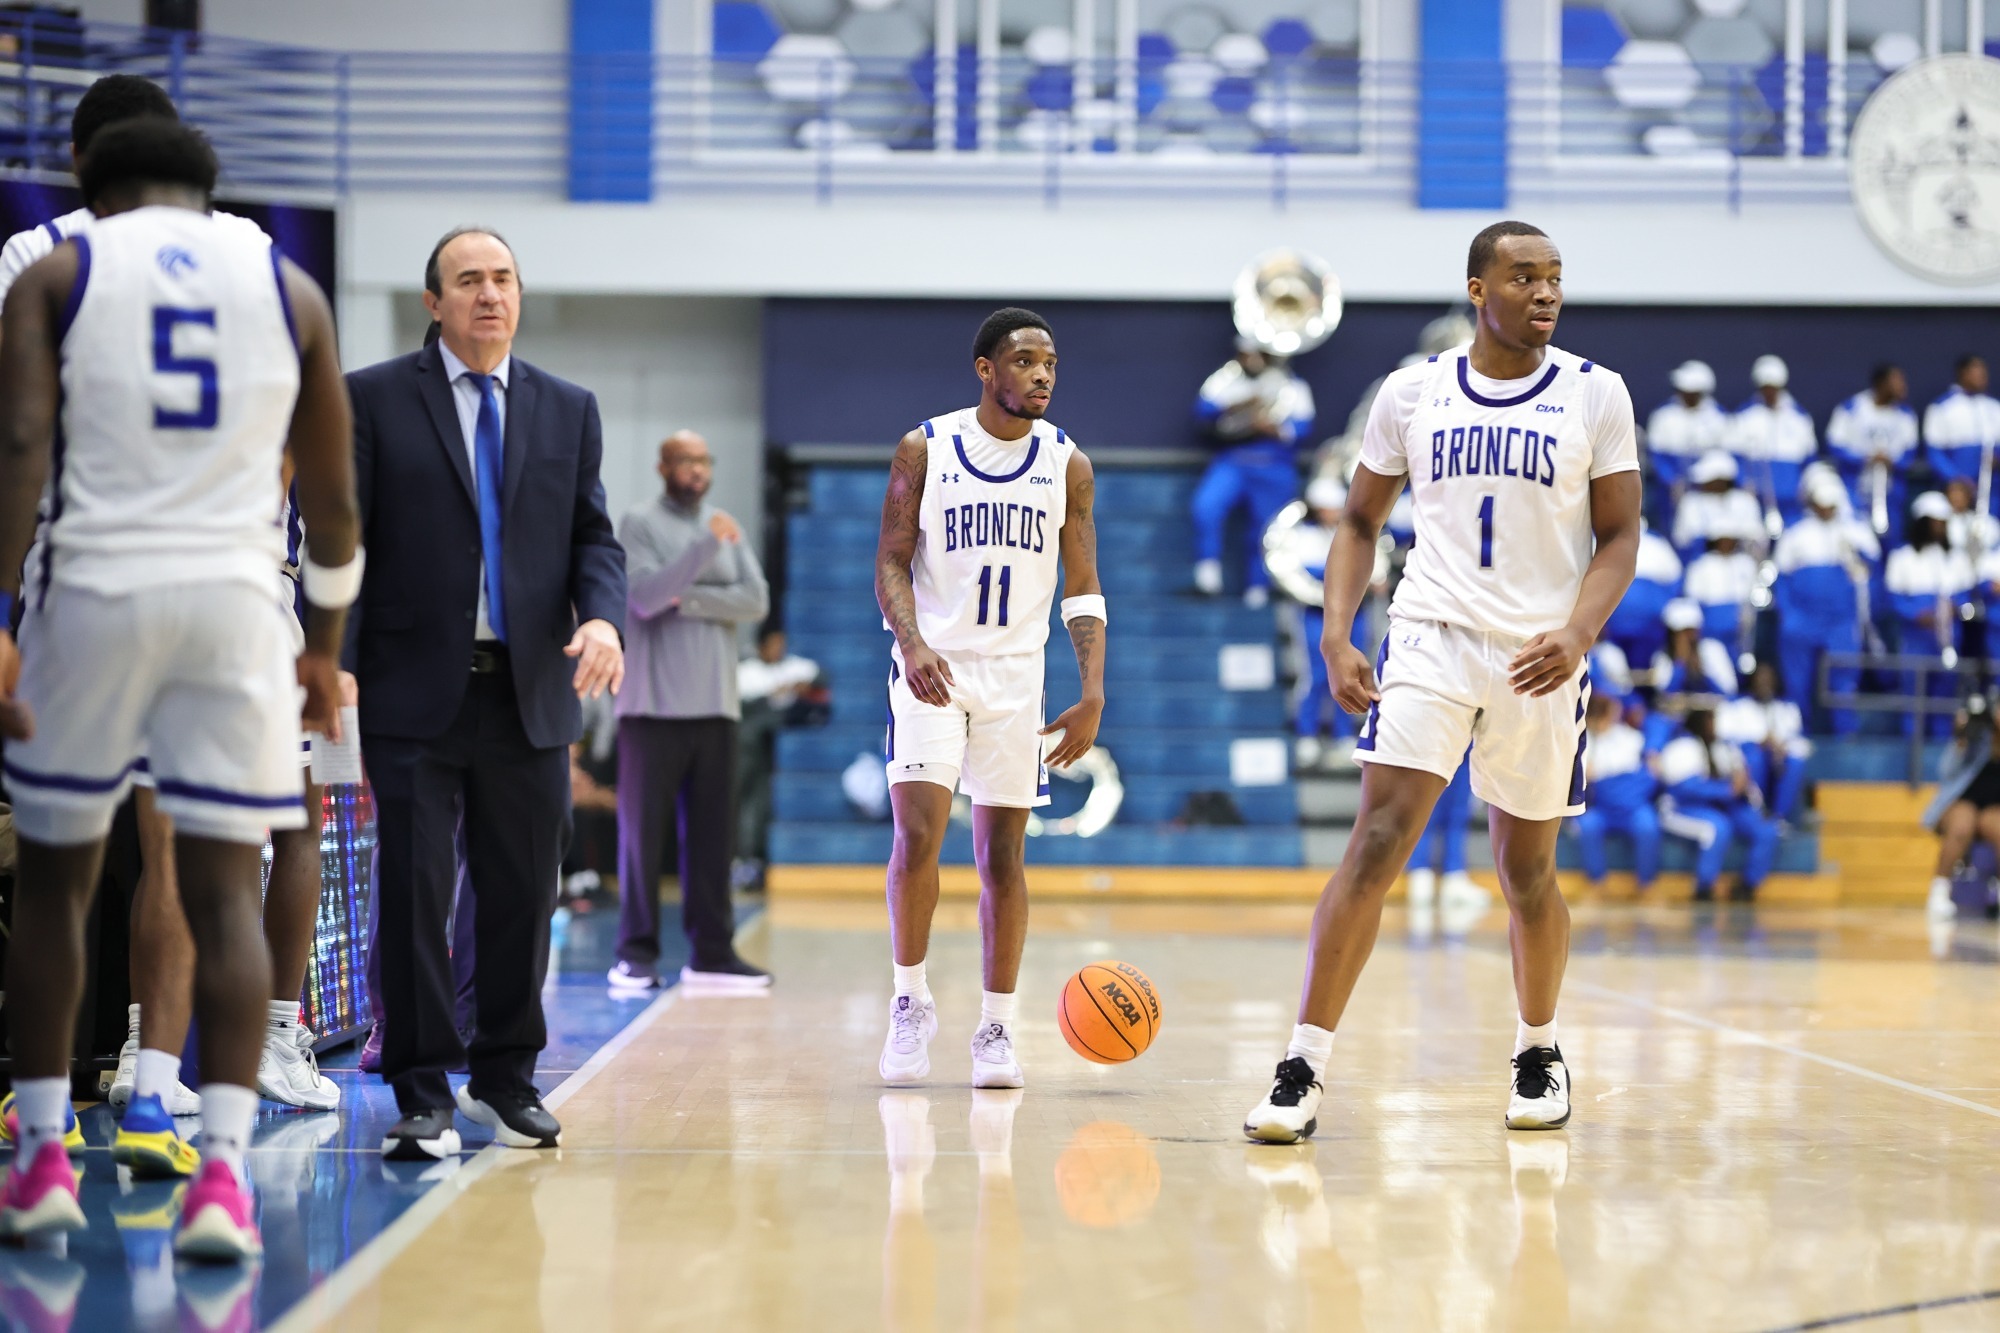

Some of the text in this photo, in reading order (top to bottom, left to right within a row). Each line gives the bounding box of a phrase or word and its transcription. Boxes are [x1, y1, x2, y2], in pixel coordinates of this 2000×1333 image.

[153, 305, 219, 429] 5
[1535, 404, 1565, 414] CIAA
[1029, 476, 1053, 486] CIAA
[1432, 426, 1557, 488] BRONCOS
[944, 502, 1047, 553] BRONCOS
[1478, 495, 1495, 568] 1
[976, 565, 1011, 627] 11
[1101, 981, 1141, 1028] NCAA
[1116, 963, 1159, 1021] Wilson
